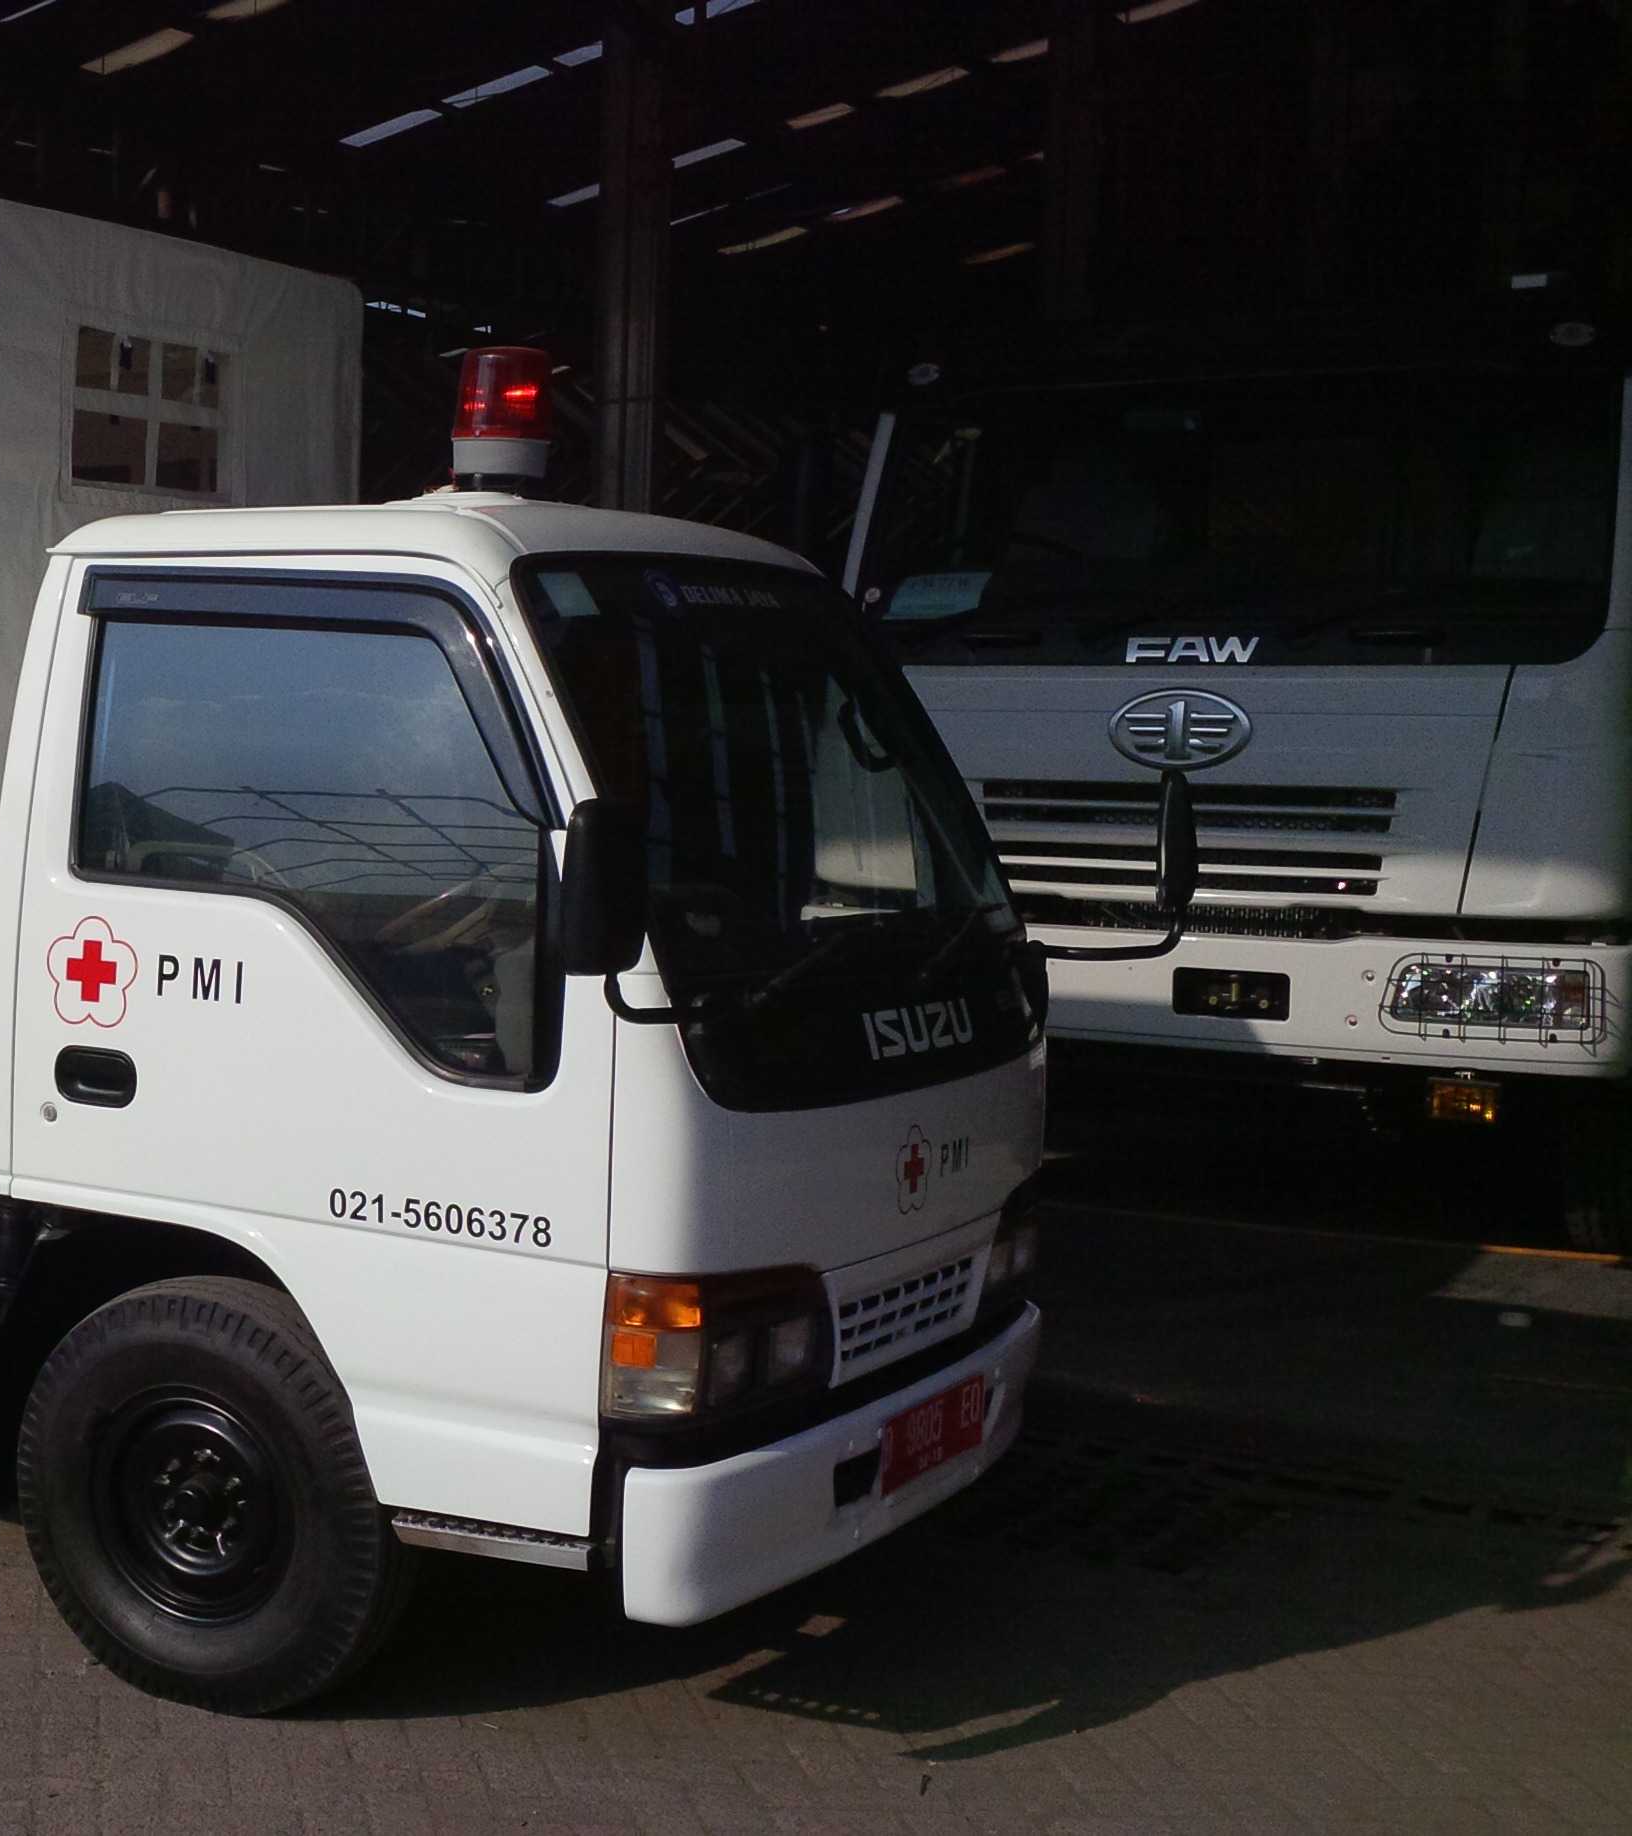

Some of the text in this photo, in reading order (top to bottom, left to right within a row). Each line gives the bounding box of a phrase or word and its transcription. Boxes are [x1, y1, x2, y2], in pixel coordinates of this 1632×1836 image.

[1125, 636, 1260, 663] FAW
[156, 953, 244, 1005] PMI
[861, 998, 973, 1061] ISUZU
[940, 1136, 969, 1177] PMI
[329, 1188, 552, 1248] 021-5606378
